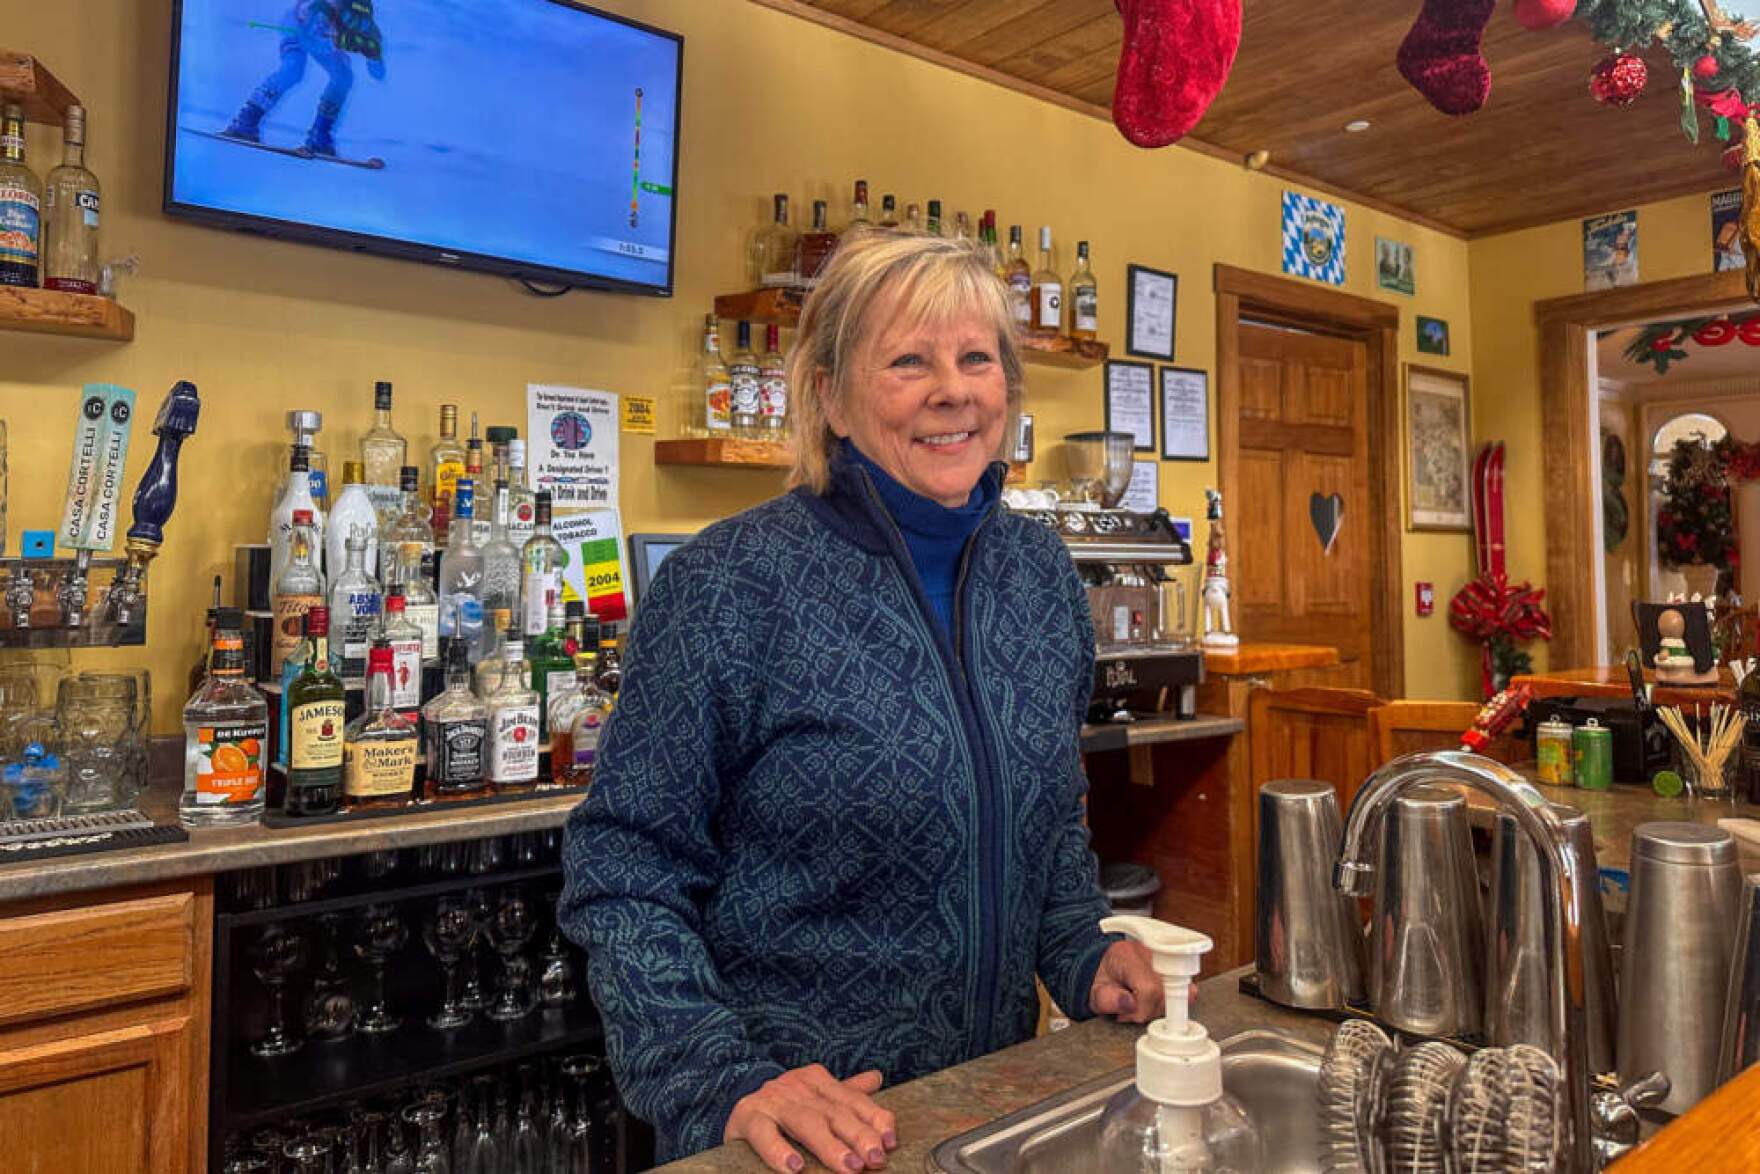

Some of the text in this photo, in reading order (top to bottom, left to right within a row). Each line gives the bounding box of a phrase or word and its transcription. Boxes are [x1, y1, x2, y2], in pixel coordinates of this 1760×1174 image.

[70, 427, 96, 538] CASA CORTELLI
[97, 430, 123, 540] CASA CORTELLI
[552, 519, 593, 530] ALCOHOL
[558, 528, 597, 540] TOBACCO
[588, 572, 620, 588] 2004
[299, 704, 345, 722] JAMESO
[211, 776, 240, 788] TRIPLE
